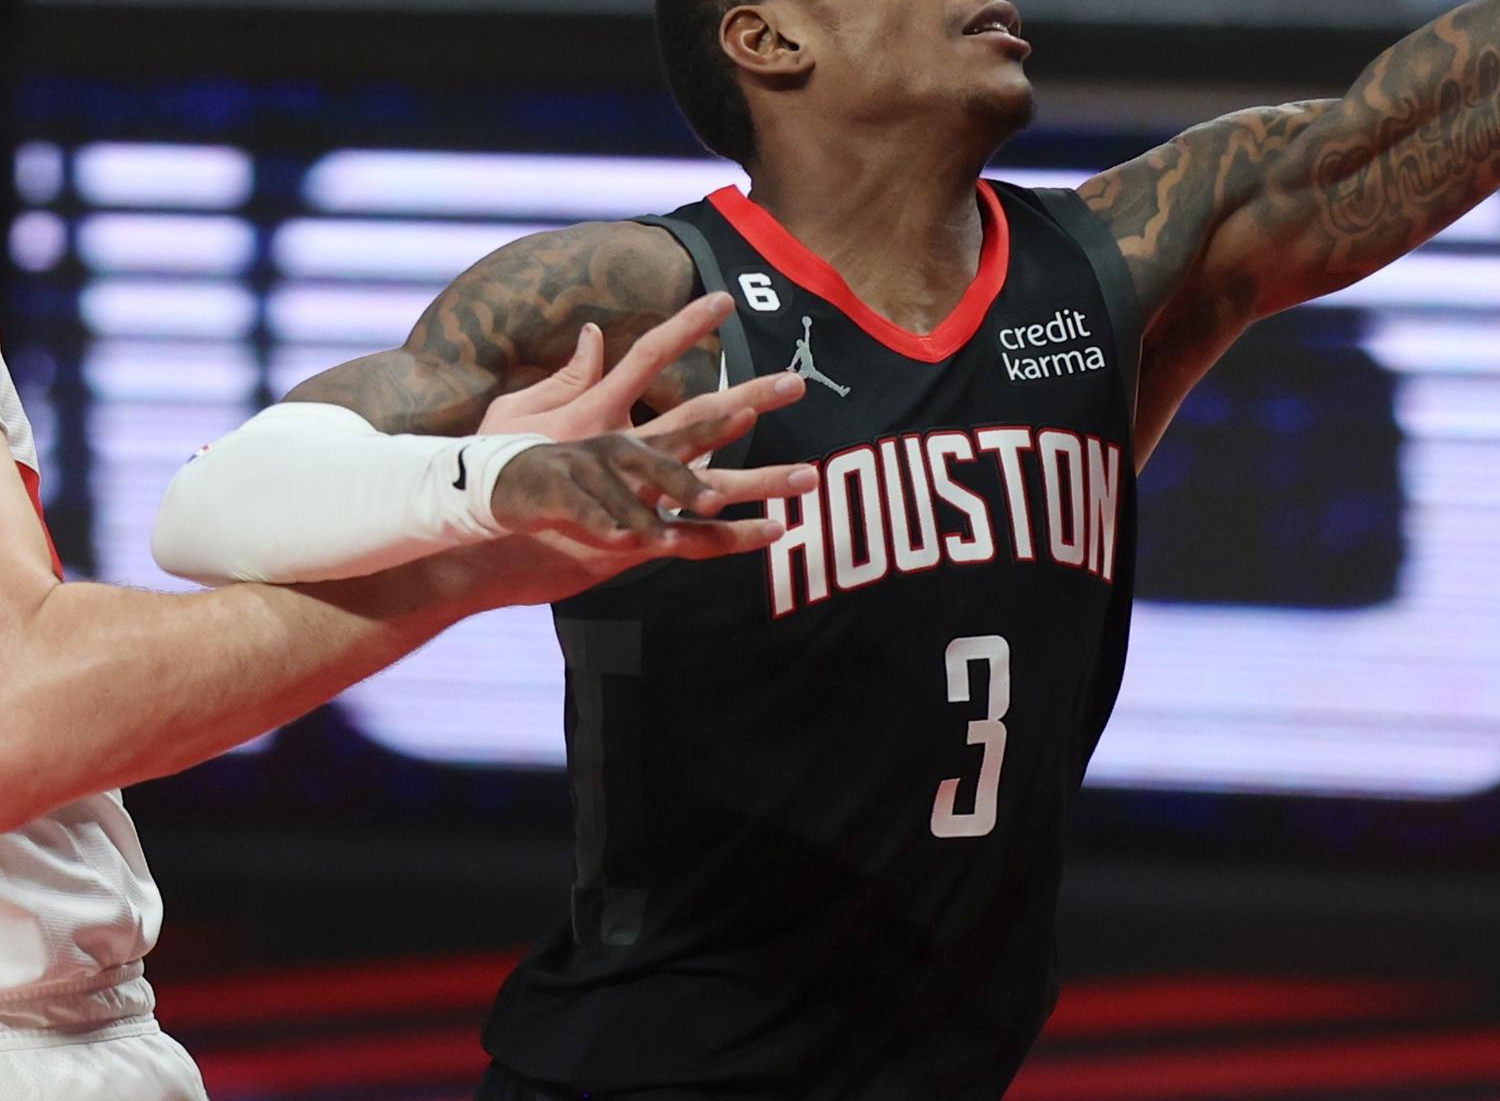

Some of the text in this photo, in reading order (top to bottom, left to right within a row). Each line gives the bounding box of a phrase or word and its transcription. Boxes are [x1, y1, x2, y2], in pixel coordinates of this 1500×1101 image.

[737, 272, 782, 312] 6
[999, 309, 1091, 352] credit
[1002, 343, 1106, 382] karma
[764, 426, 1120, 619] HOUSTON
[930, 634, 1011, 838] 3
